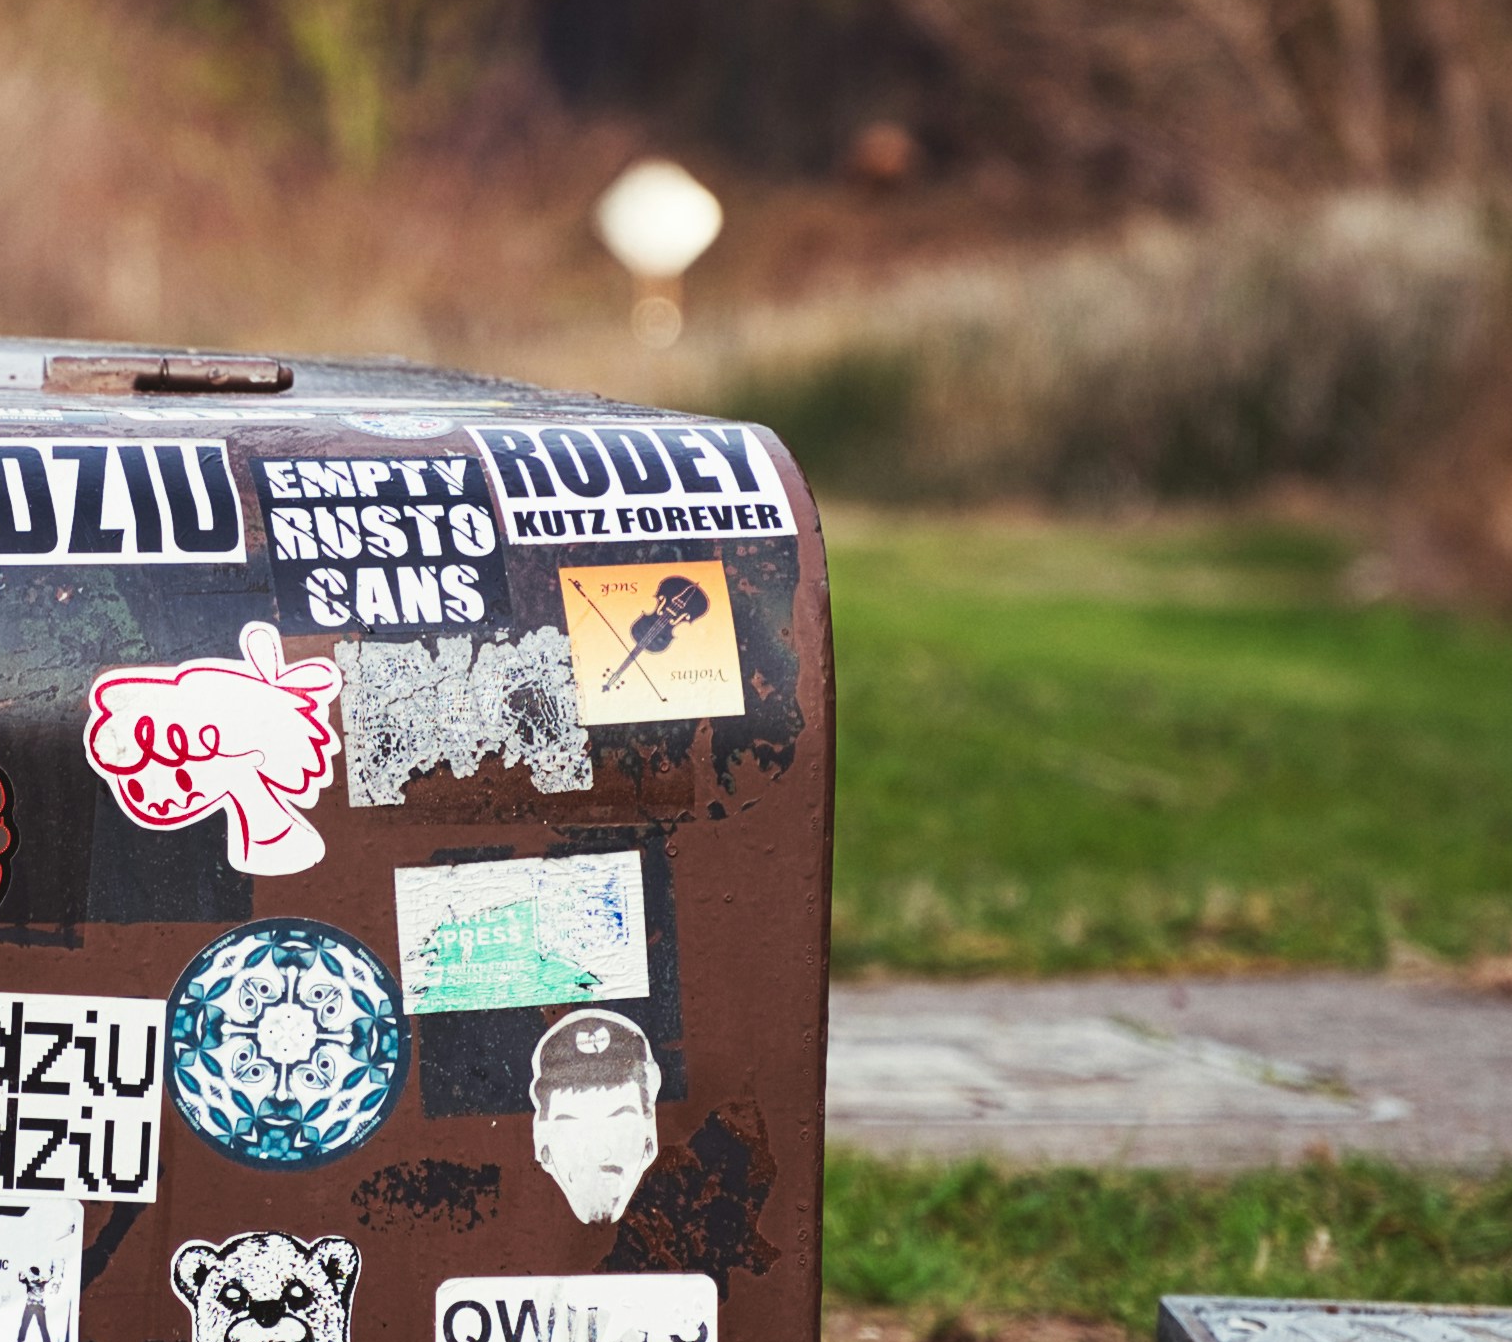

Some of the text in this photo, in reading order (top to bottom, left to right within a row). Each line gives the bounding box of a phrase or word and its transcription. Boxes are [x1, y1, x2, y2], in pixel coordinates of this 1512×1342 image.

[262, 459, 468, 499] EMPTY
[477, 428, 764, 500] RODEY
[271, 503, 496, 561] RUSTO
[514, 504, 784, 537] KUTZ FOREVER
[306, 565, 486, 628] CANS
